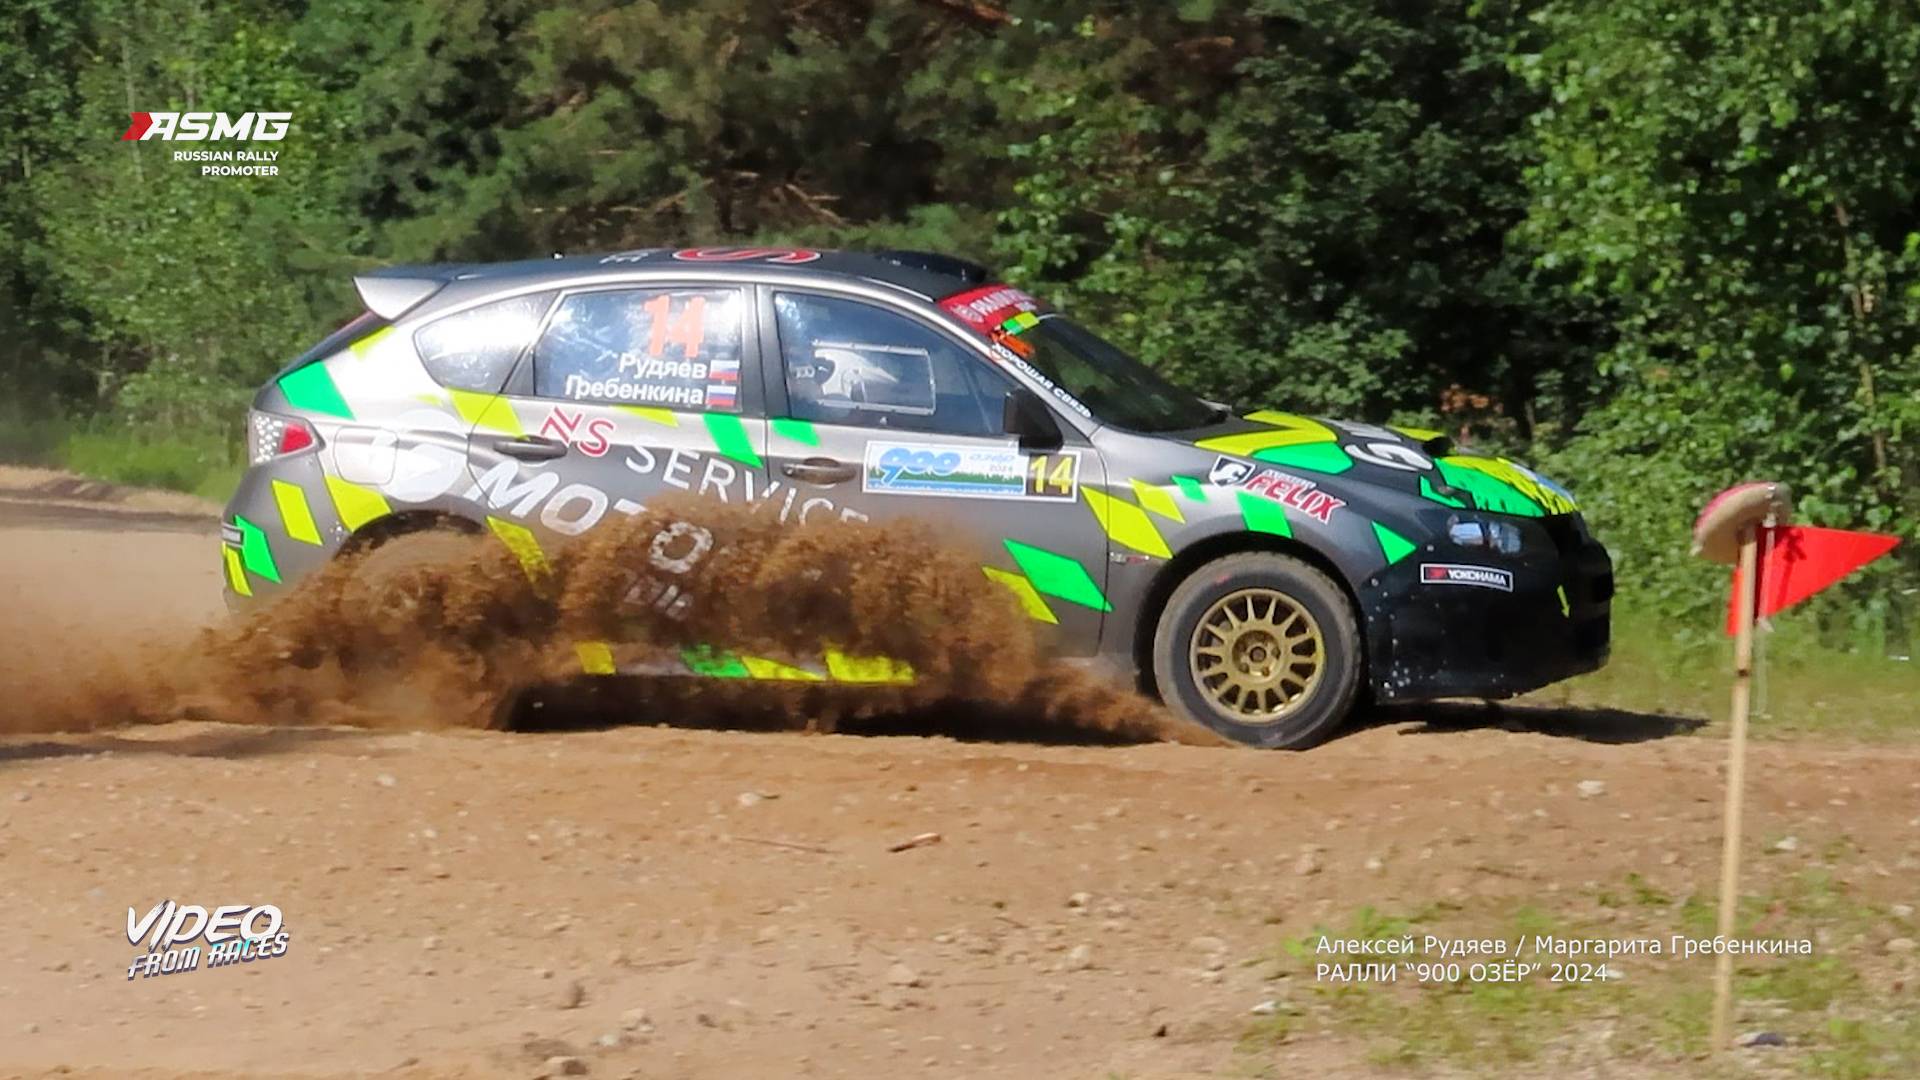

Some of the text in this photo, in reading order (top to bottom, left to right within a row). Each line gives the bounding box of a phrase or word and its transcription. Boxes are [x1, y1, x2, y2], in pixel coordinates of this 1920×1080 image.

[643, 294, 706, 358] 14
[565, 374, 704, 406] Гребенкина
[618, 354, 707, 380] Рудяев
[992, 342, 1055, 391] ХОРОШАЯ
[879, 447, 1074, 495] 900 14
[1242, 474, 1347, 525] FELIX
[1447, 569, 1507, 586] YOKOHAMA
